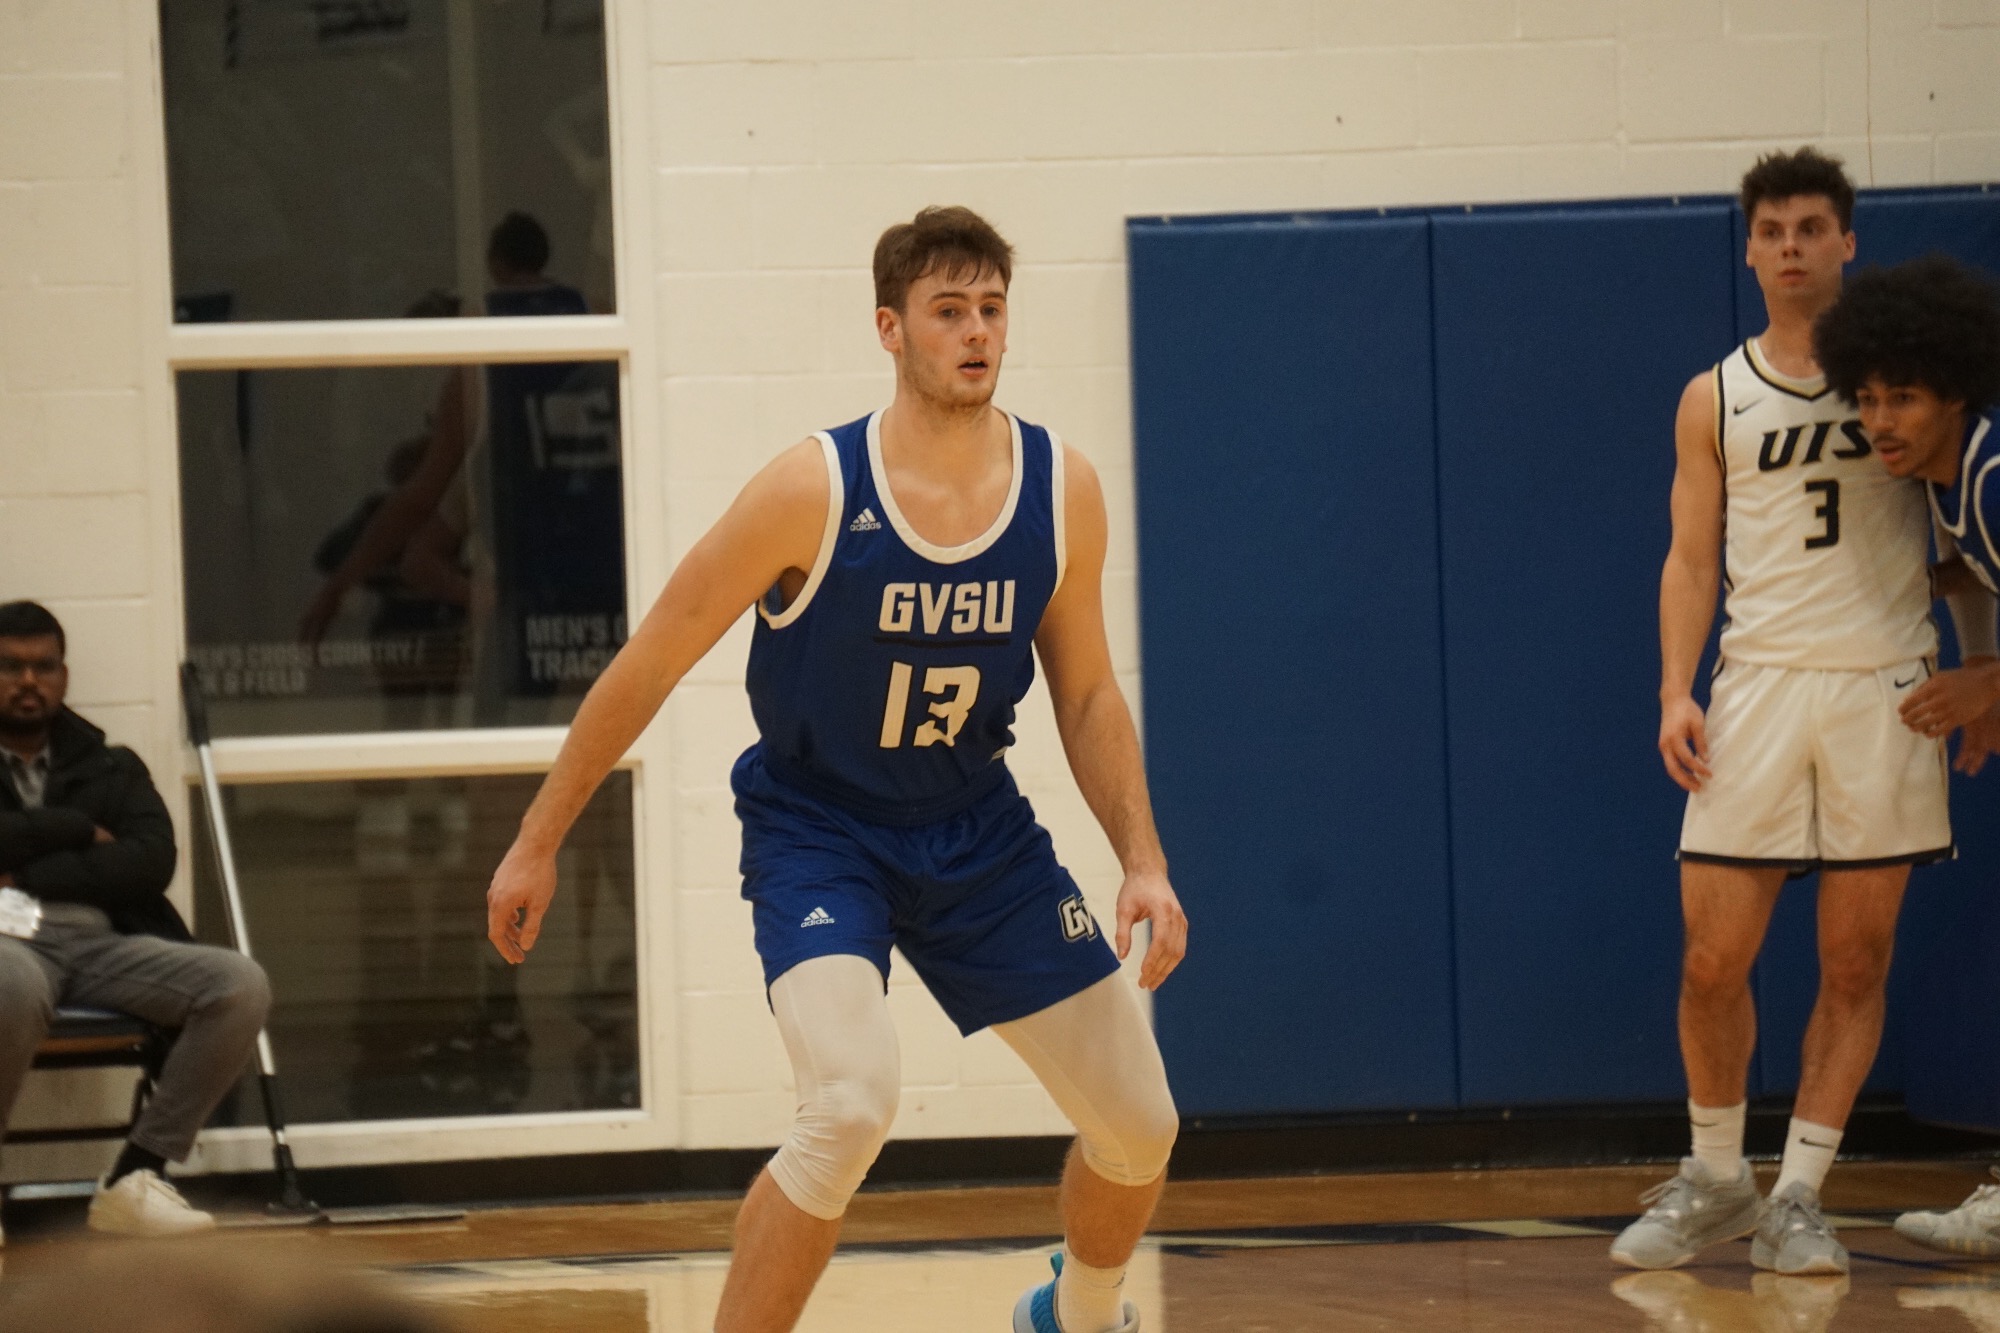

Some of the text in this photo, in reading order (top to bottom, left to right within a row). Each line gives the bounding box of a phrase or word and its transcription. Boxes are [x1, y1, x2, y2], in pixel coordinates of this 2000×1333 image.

[1758, 419, 1872, 473] UIS
[850, 520, 882, 532] adidas
[1804, 480, 1840, 550] 3
[878, 579, 1016, 635] GVSU
[879, 660, 981, 749] 13
[800, 916, 836, 929] adidas
